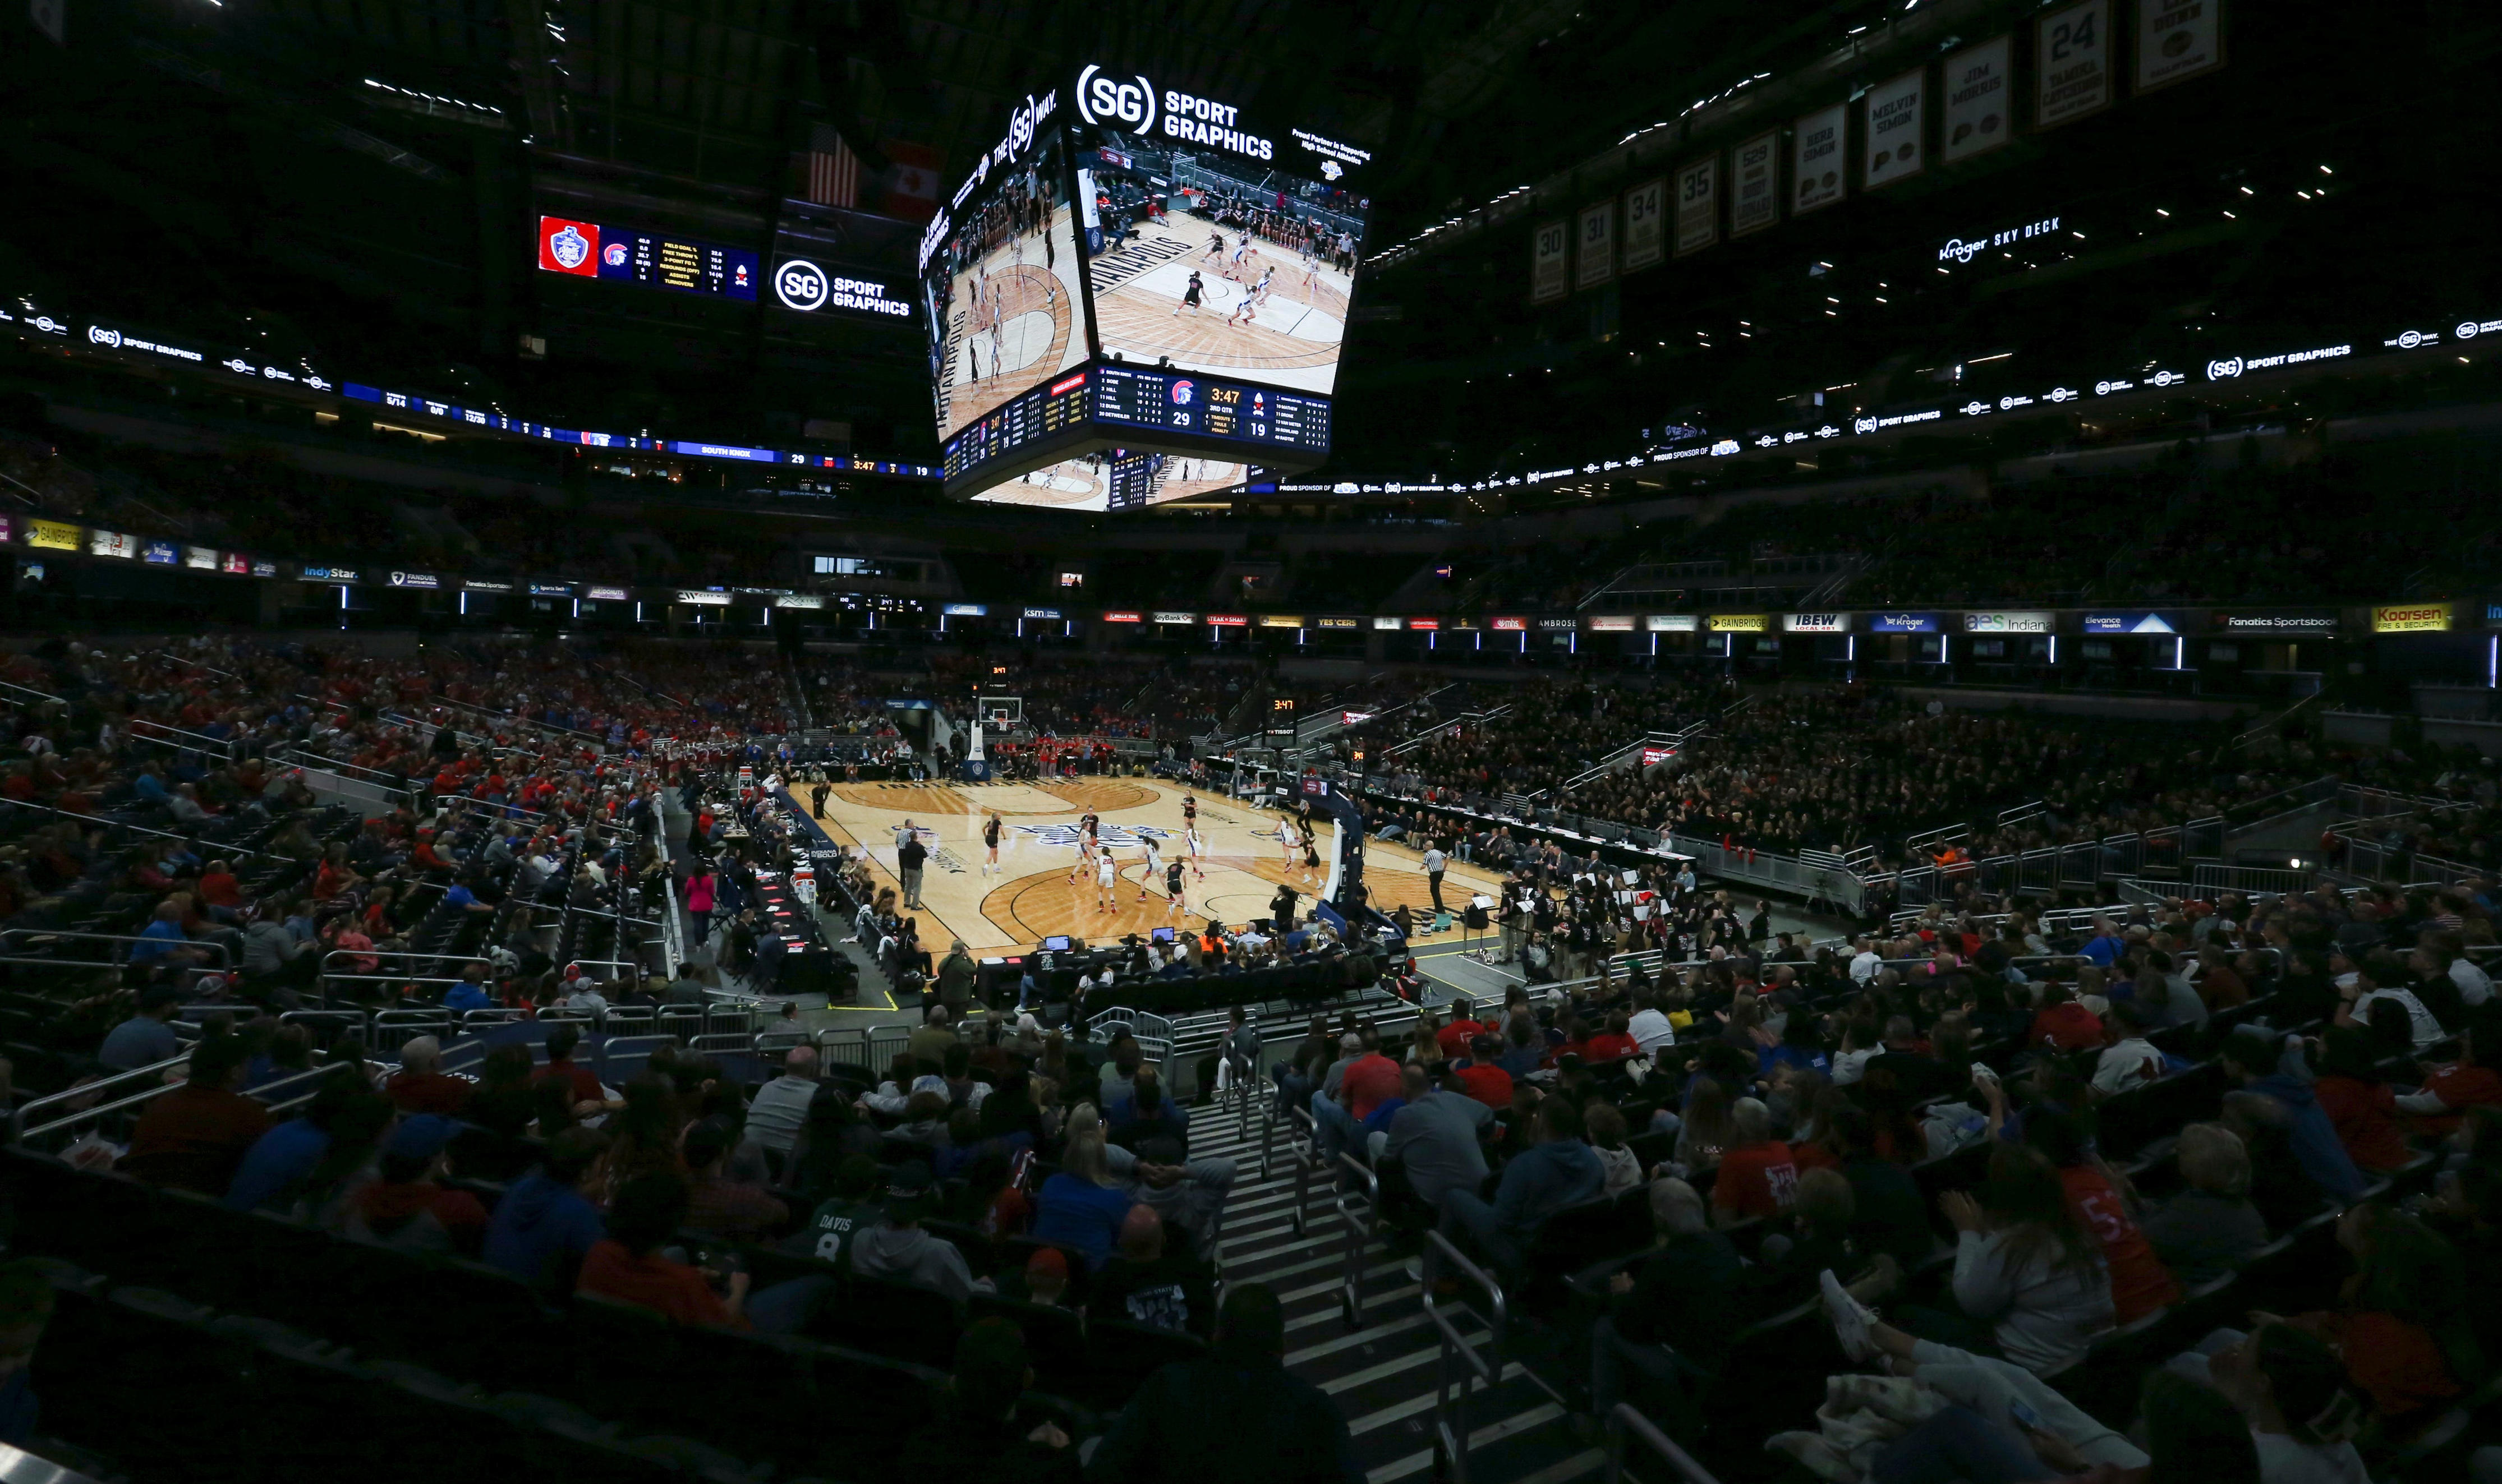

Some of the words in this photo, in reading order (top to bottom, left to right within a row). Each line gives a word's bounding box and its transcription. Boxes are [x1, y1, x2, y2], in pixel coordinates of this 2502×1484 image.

[2052, 11, 2095, 62] 24
[1965, 63, 1989, 82] JIM
[1952, 77, 2001, 106] MORRIS
[1165, 90, 1238, 126] SPORT
[1873, 93, 1916, 121] MELVIN
[994, 137, 1008, 167] THE
[1036, 89, 1056, 125] WAY.
[1877, 110, 1912, 135] SIMON
[1164, 115, 1272, 160] GRAPHICS
[1292, 128, 1310, 140] Proud
[1311, 134, 1333, 147] Partner
[1340, 144, 1370, 161] Supporting
[1807, 127, 1834, 147] HERB
[1301, 140, 1316, 151] High
[1316, 145, 1336, 157] School
[1336, 150, 1362, 165] Athletics
[1744, 145, 1767, 168] 529
[1803, 141, 1835, 162] SIMON
[1685, 168, 1708, 201] 35
[1632, 189, 1655, 221] 34
[1587, 214, 1605, 242] 31
[1541, 229, 1561, 257] 30
[1939, 238, 1988, 263] Kroger
[1994, 228, 2018, 246] SKY
[2025, 217, 2060, 238] DECK
[660, 263, 686, 273] REBOUNDS
[664, 257, 684, 265] 3-POINT
[665, 278, 693, 288] TURNOVERS
[834, 278, 885, 297] SPORT
[833, 292, 909, 316] GRAPHICS
[2421, 333, 2439, 341] WAY.
[123, 337, 155, 351] SPORT
[157, 341, 203, 361] GRAPHICS
[2247, 355, 2286, 370] SPORT
[2287, 345, 2351, 363] GRAPHICS
[387, 397, 406, 407] 5/14
[1211, 388, 1240, 404] 3:47
[430, 406, 444, 416] 0/0
[1105, 411, 1130, 420] DETWEILER
[1221, 405, 1233, 414] QTR
[465, 413, 485, 425] 12/30
[1172, 412, 1190, 426] 29
[1879, 416, 1902, 427] SPORT
[1903, 410, 1940, 423] GRAPHICS
[1250, 422, 1266, 436] 19
[1003, 436, 1009, 449] 19
[701, 446, 728, 455] SOUTH
[730, 449, 751, 458] KNOX
[791, 454, 805, 464] 29
[1654, 453, 1672, 462] PROUD
[1673, 449, 1699, 459] SPONSOR
[853, 460, 875, 470] 3:47
[916, 466, 928, 476] 19
[41, 527, 80, 546] GAINBRIDGE
[407, 573, 438, 582] FANDUEL
[1024, 607, 1044, 617] ksm
[1795, 615, 1837, 625] IBEW
[2085, 616, 2121, 624] Elevance
[2378, 609, 2441, 622] Koorsen
[1505, 619, 1519, 627] mhs
[1722, 619, 1766, 628] GAINBRIDGE
[1896, 615, 1924, 630] Kroger
[1966, 614, 2004, 631] aes
[2008, 619, 2053, 631] Indiana
[2229, 617, 2273, 626] Fanatics
[2274, 617, 2338, 628] Sportsbook
[1274, 700, 1293, 710] 3:47
[819, 1214, 852, 1232] DAVIS
[815, 1232, 840, 1263] 8
